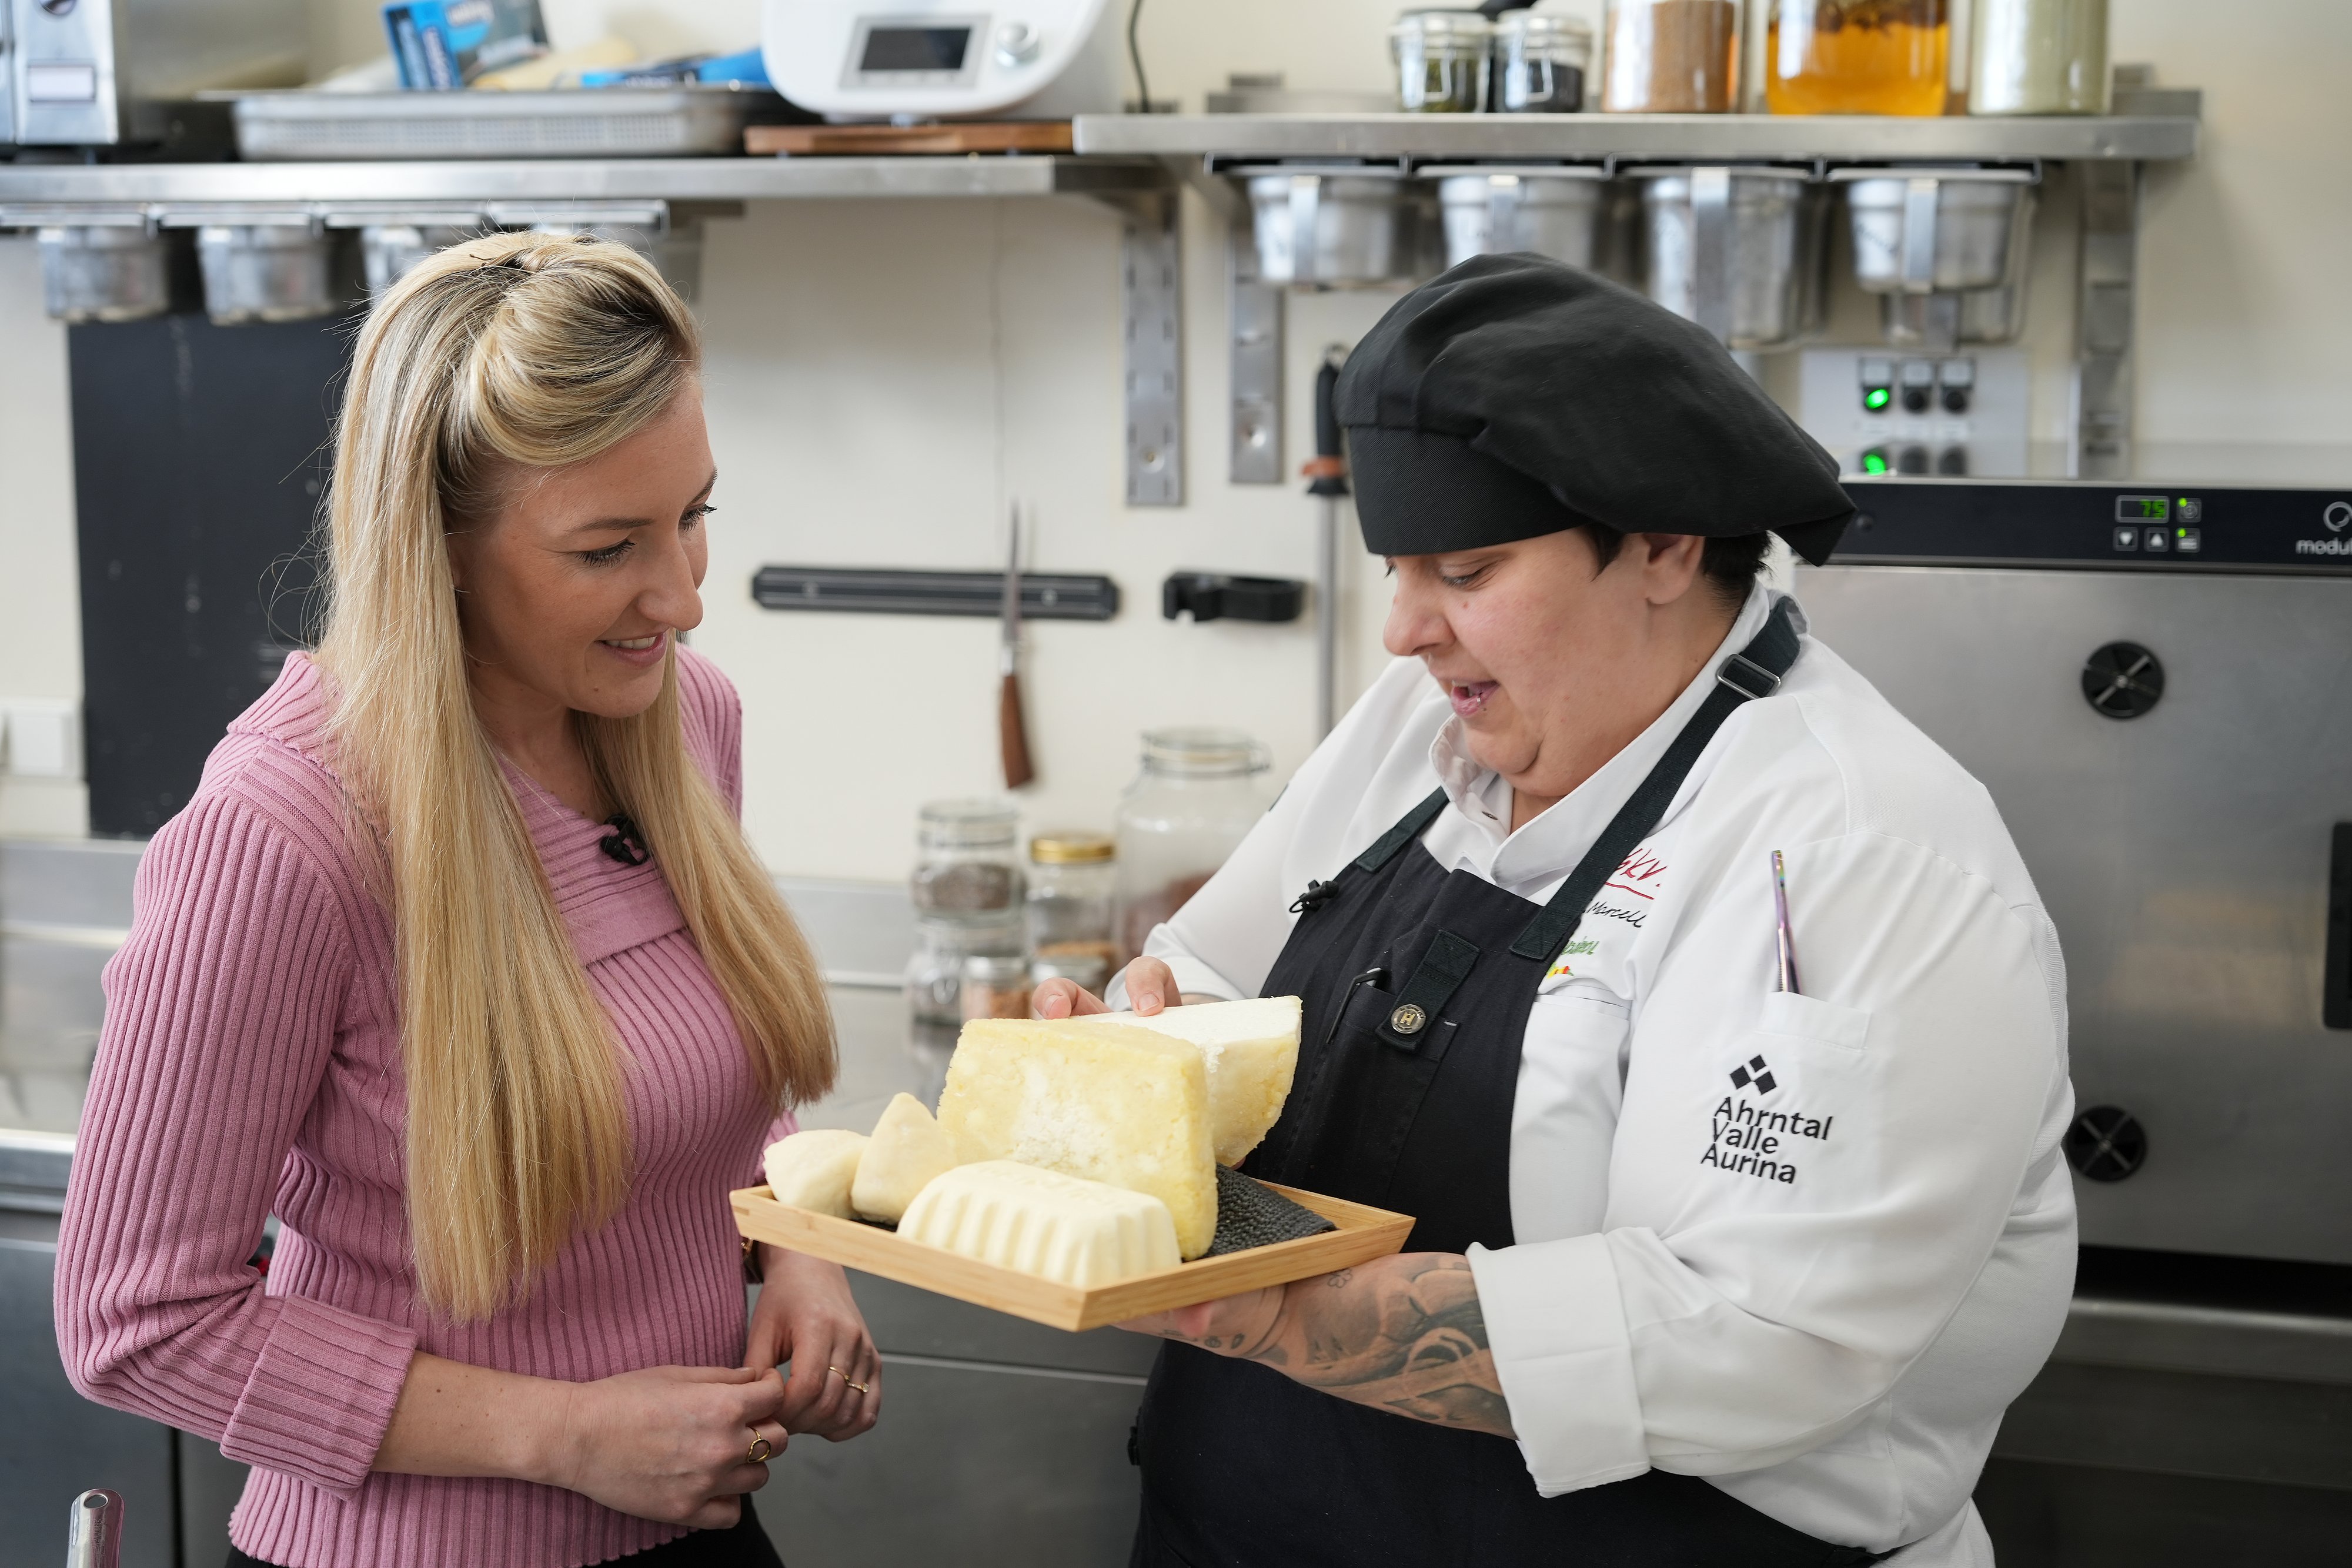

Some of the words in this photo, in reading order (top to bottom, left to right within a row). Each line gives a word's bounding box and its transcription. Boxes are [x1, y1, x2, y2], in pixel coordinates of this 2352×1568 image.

[2140, 499, 2166, 519] 75
[1712, 1118, 1778, 1154] Valle
[1714, 1096, 1833, 1140] Ahrntal
[1700, 1143, 1796, 1183] Aurina
